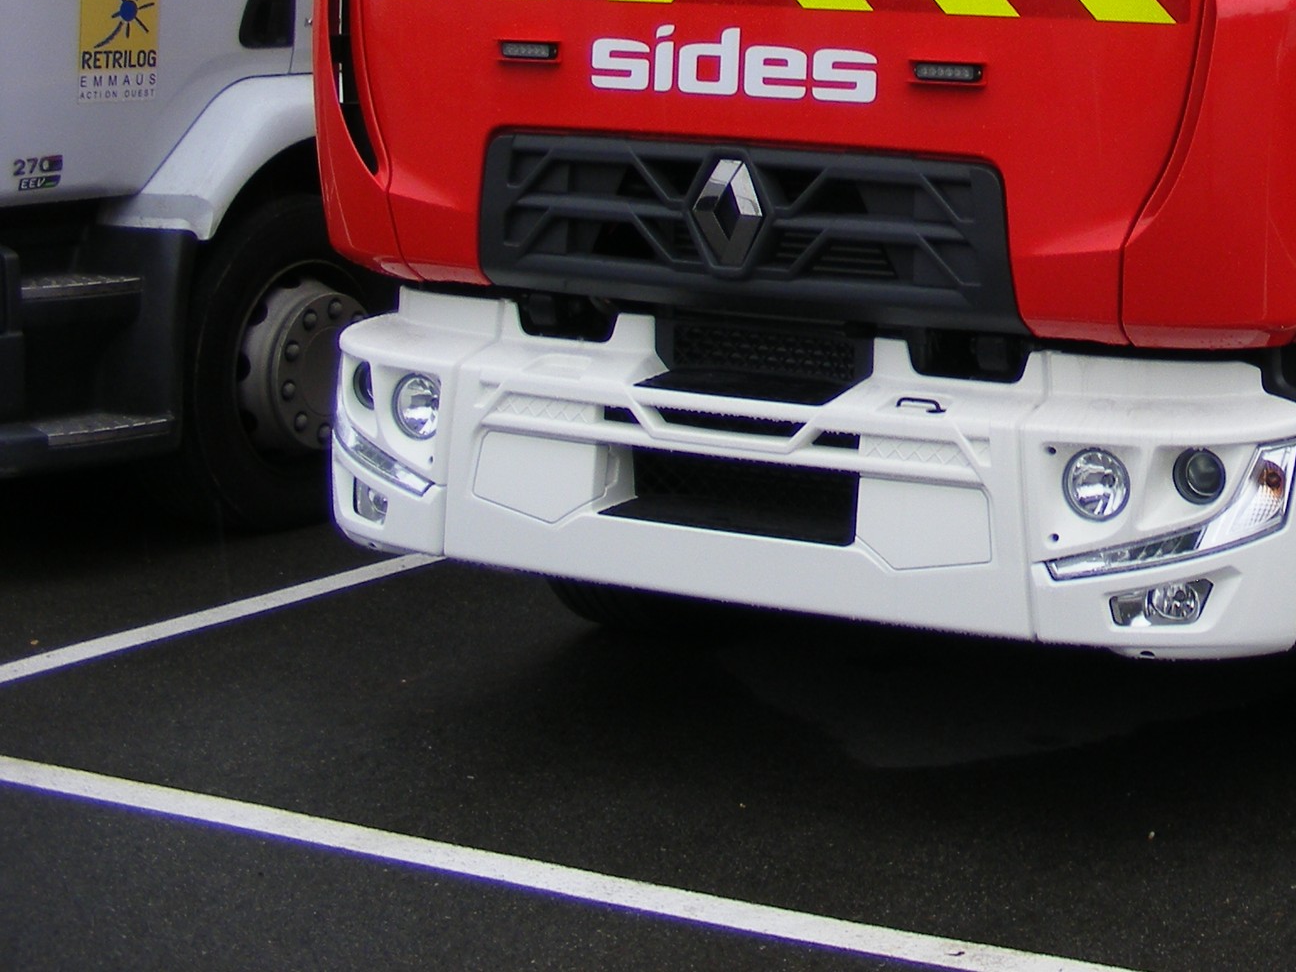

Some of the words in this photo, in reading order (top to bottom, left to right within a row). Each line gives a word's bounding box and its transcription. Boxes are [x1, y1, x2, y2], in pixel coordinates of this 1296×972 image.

[81, 49, 157, 69] RETRILOG
[591, 24, 878, 103] sides
[80, 73, 157, 88] EMMAUS
[80, 90, 118, 100] ACTION
[124, 89, 155, 98] OUEST
[13, 156, 51, 176] 270
[20, 177, 46, 189] EEV
